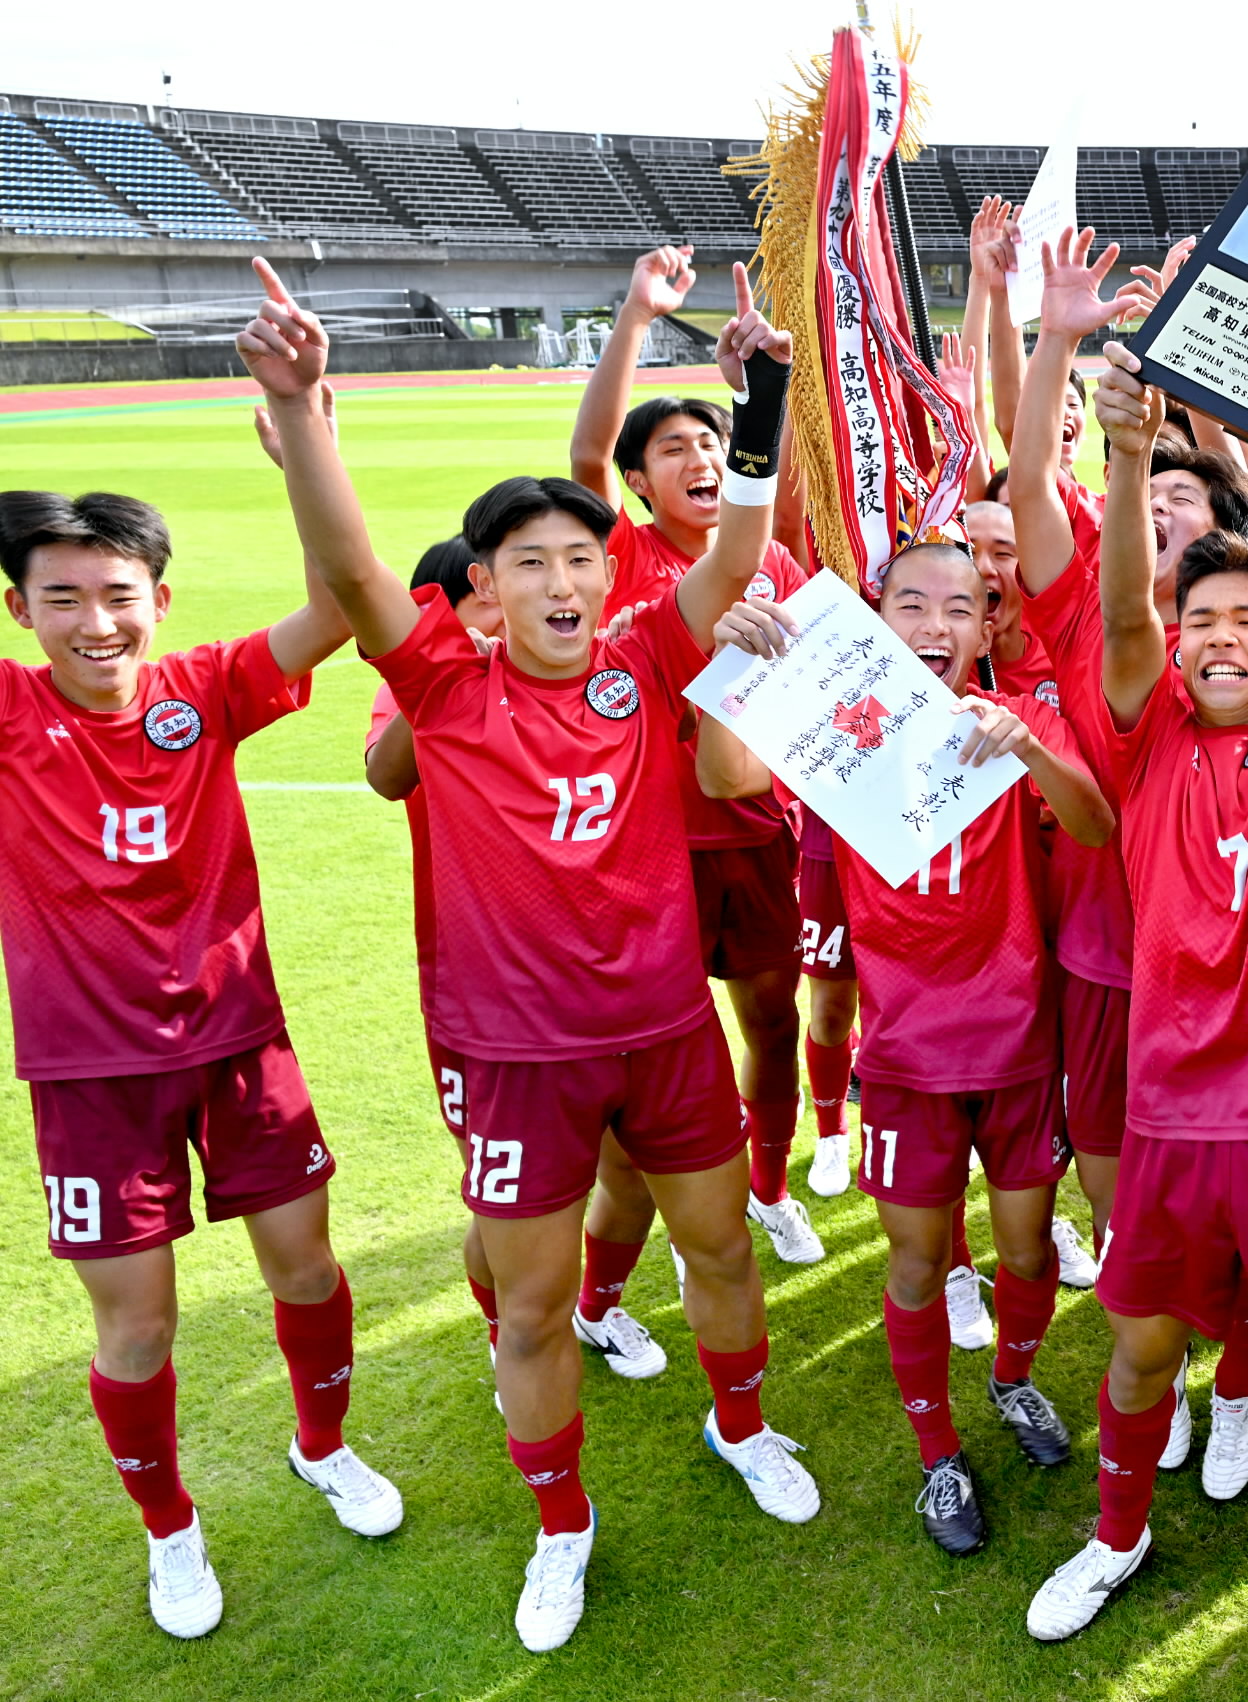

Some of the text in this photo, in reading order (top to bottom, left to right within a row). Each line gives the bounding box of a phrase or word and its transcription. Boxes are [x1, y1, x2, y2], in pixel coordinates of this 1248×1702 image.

[1183, 343, 1225, 369] FUJIFILM
[840, 351, 885, 518] 高知高等学校
[818, 635, 874, 690] 表彰する
[602, 685, 626, 704] 高知
[161, 717, 187, 735] 高知
[98, 802, 169, 863] 19
[548, 772, 617, 842] 12
[901, 773, 965, 832] 表彰状
[801, 918, 845, 969] 24
[441, 1066, 468, 1126] 2
[468, 1132, 524, 1204] 12
[862, 1122, 899, 1189] 11
[44, 1174, 102, 1243] 19
